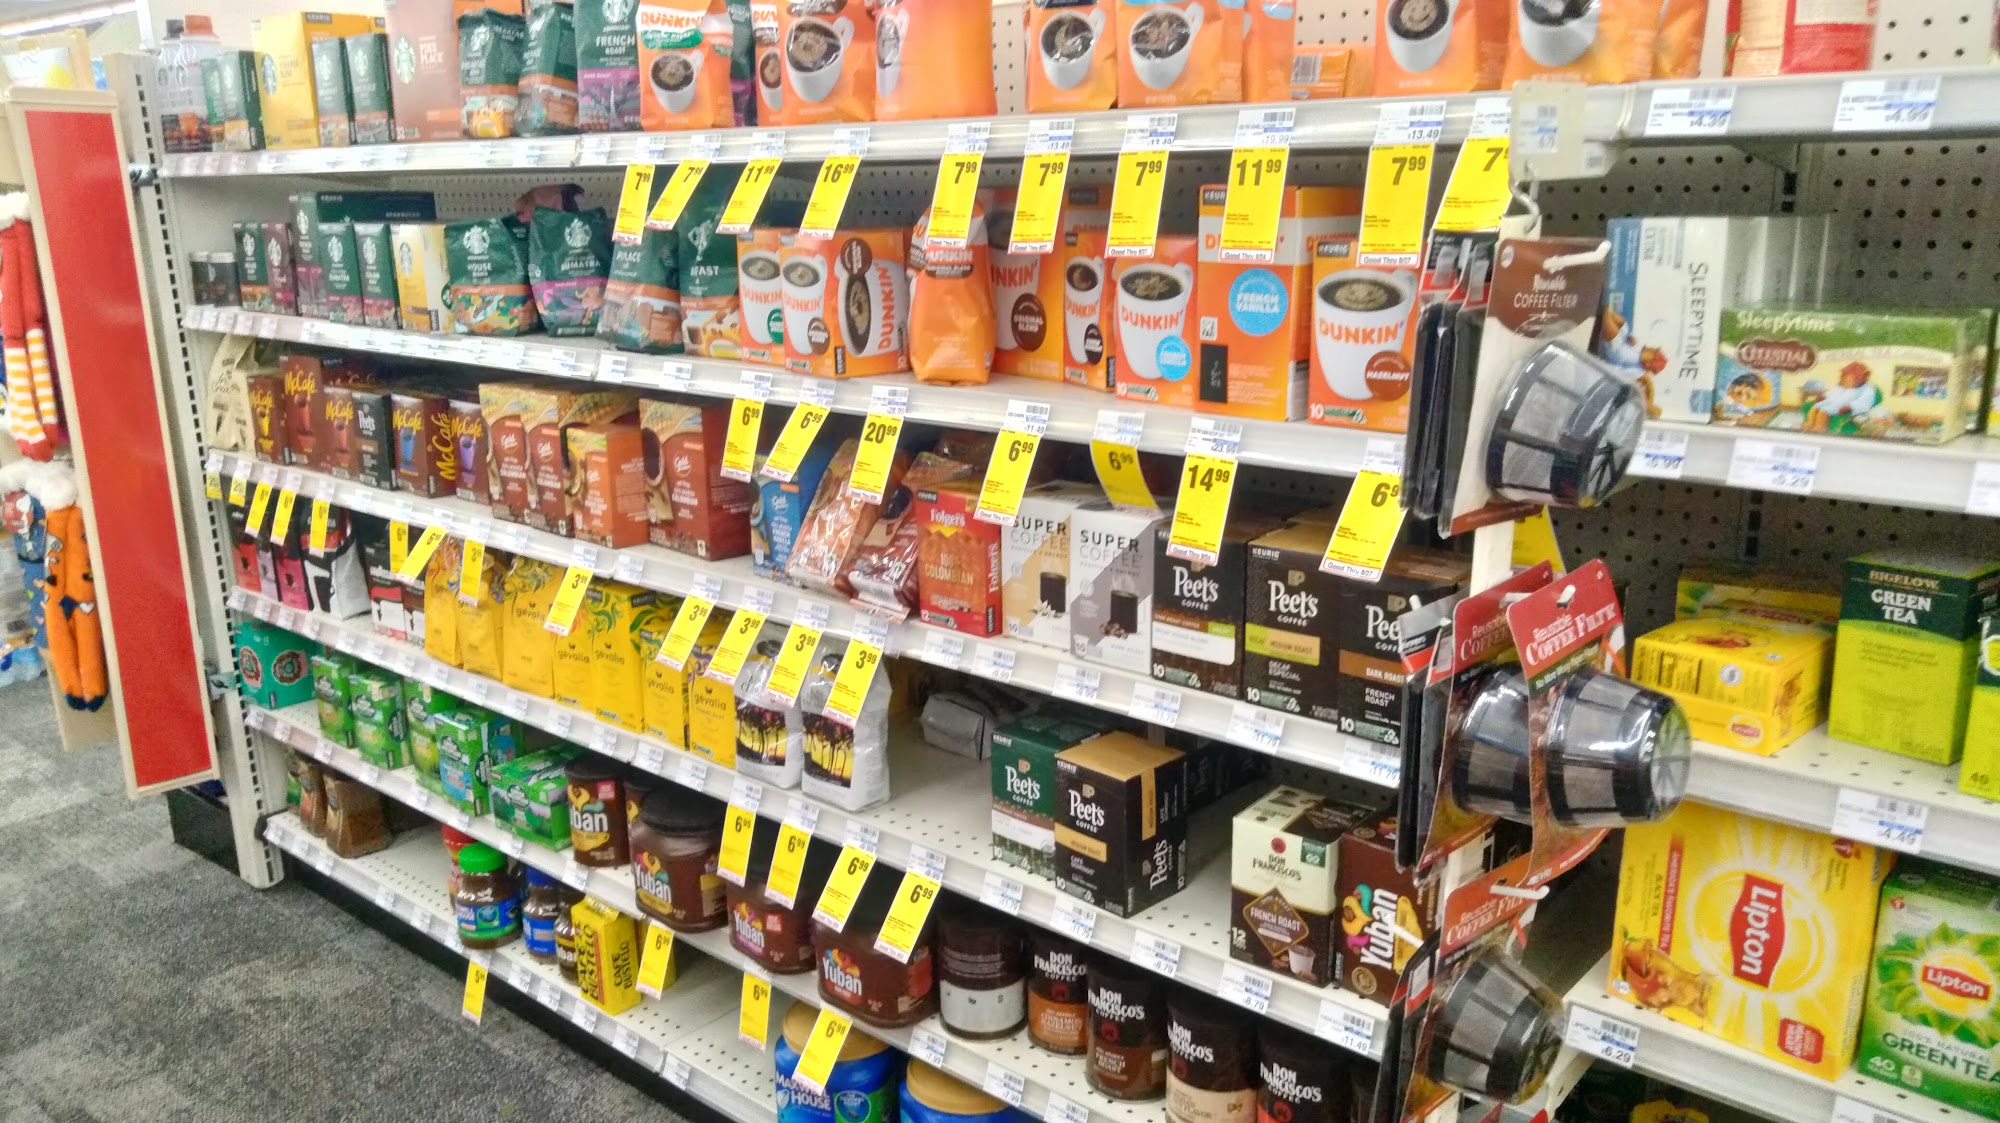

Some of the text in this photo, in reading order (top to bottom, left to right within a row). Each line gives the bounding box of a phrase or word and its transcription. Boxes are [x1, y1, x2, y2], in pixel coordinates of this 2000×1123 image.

[595, 35, 635, 47] FRENCH
[1262, 134, 1290, 145] $19.99
[1408, 128, 1439, 140] $13.49
[1111, 247, 1139, 256] Good Thru
[1224, 252, 1254, 261] Good Thru
[1318, 243, 1348, 254] KEURIG
[560, 258, 600, 272] SUMATRA
[1364, 256, 1379, 265] Good
[1381, 256, 1396, 265] Thru
[1532, 274, 1567, 291] Reusable
[877, 262, 896, 351] DUNKIN'
[1236, 292, 1279, 304] FRENCH
[1513, 292, 1578, 308] COFFEE FILTER
[1235, 301, 1280, 314] VANILLA
[1013, 314, 1044, 326] ORIGINAL
[1122, 306, 1183, 331] DUNKIN'
[1679, 262, 1709, 379] SLEEPYTIME
[1736, 309, 1836, 334] Sleepytime
[1018, 323, 1039, 332] BLEND
[1319, 319, 1404, 345] DUNKIN'
[1366, 371, 1411, 381] HAZELNUT
[1117, 382, 1128, 397] 10
[1309, 404, 1324, 420] 10
[1211, 444, 1236, 455] $23.99
[930, 508, 966, 527] Folgers
[1012, 515, 1067, 536] SUPER
[1010, 528, 1069, 549] COFFEE
[1080, 529, 1139, 552] SUPER
[1079, 545, 1143, 568] COFFEE
[1172, 546, 1200, 559] Good Thru
[1252, 547, 1280, 558] KEURIG
[924, 564, 974, 586] COLOMBIAN
[988, 543, 999, 594] Folgers
[1327, 561, 1373, 577] Good Thru 8/27
[1172, 565, 1219, 603] Peet's
[1869, 569, 1940, 591] BIGELOW
[1181, 599, 1209, 611] COFFEE
[1268, 580, 1318, 618] Peet's
[1871, 588, 1932, 612] GREEN
[920, 608, 930, 621] 12
[1277, 613, 1307, 627] COFFEE
[1881, 604, 1918, 624] TEA
[1181, 618, 1200, 628] COFFEE
[1533, 614, 1573, 642] Reusable
[1525, 626, 1577, 666] COFFEE
[1153, 662, 1165, 678] 10
[1268, 660, 1291, 670] DECAF
[1268, 667, 1301, 681] ESPECIAL
[1366, 667, 1405, 684] DARK ROAST
[694, 692, 727, 712] gevalia
[1247, 686, 1260, 702] 10
[1365, 687, 1396, 702] FRENCH
[1365, 695, 1390, 708] ROAST
[1340, 717, 1355, 733] 10
[992, 734, 1013, 747] KEURIG
[1057, 760, 1077, 774] KEURIG
[1005, 765, 1041, 800] Peet's
[1012, 794, 1033, 807] COFFEE
[1068, 789, 1105, 827] Peet's
[1075, 820, 1098, 834] COFFEE
[1149, 839, 1168, 891] Peet's
[1268, 853, 1287, 866] DON
[1252, 857, 1302, 881] FRANCISCO'S
[633, 863, 672, 904] Yuban
[1056, 876, 1066, 890] 10
[733, 909, 765, 947] Yuban
[1250, 907, 1301, 932] FRENCH ROAST
[1446, 909, 1496, 946] COFFEE
[1231, 926, 1246, 941] 12
[1359, 888, 1398, 970] Yuban
[1740, 885, 1778, 975] Lipton
[1034, 954, 1087, 976] FRANCISCO
[1050, 951, 1073, 963] DON
[822, 956, 863, 996] Yuban
[1045, 972, 1076, 982] COFFEE
[1927, 968, 1985, 997] Lipton
[1100, 986, 1122, 1003] DON
[1088, 988, 1145, 1020] FRANCISCO'S
[1096, 1009, 1125, 1022] COFFEE
[1173, 1020, 1192, 1043] DON
[1095, 1053, 1126, 1069] FRENCH
[1601, 1045, 1632, 1064] $6.29
[1882, 1031, 2000, 1084] GREEN TEA
[1936, 1041, 1990, 1065] NATURAL
[1097, 1061, 1122, 1075] ROAST
[1868, 1055, 1896, 1071] 40
[1272, 1062, 1297, 1083] DON
[1260, 1062, 1322, 1103] FRANCISCO'S
[791, 1091, 832, 1110] HOUSE
[1268, 1085, 1301, 1104] COFFEE
